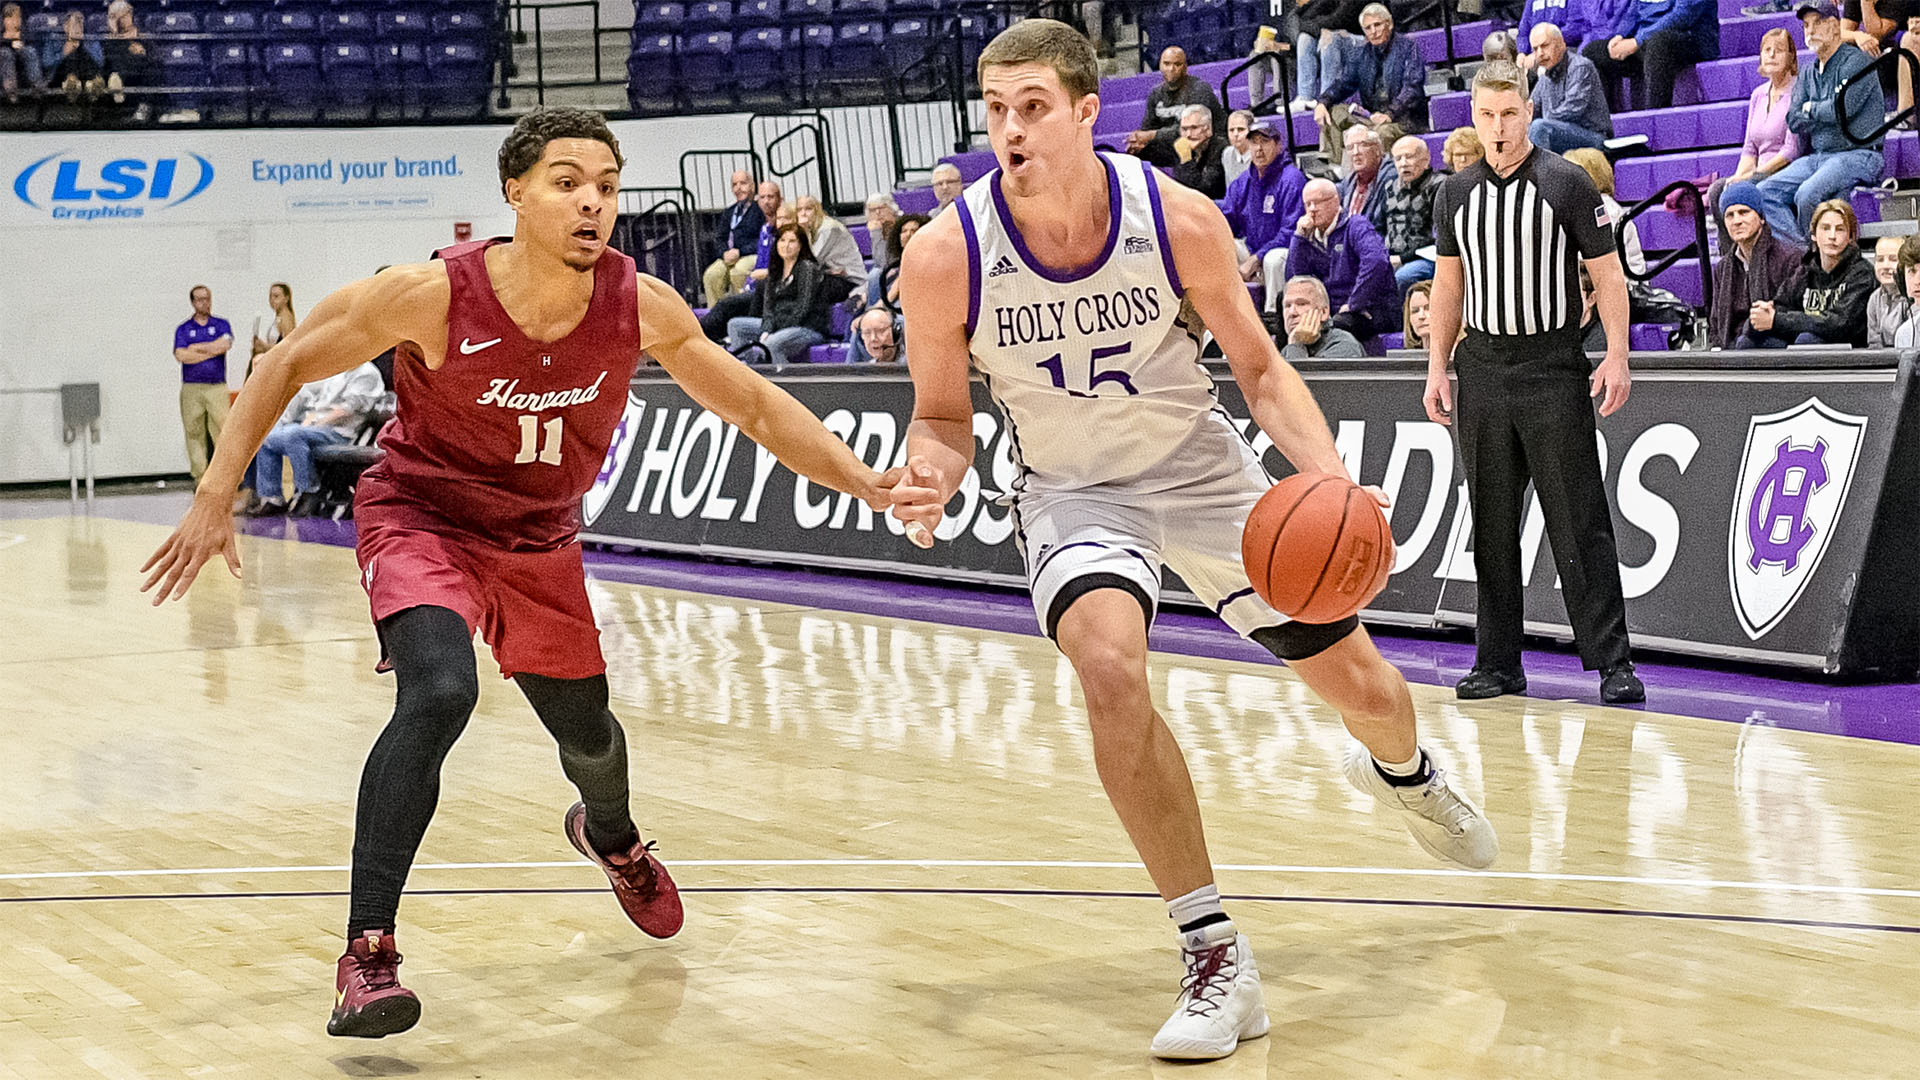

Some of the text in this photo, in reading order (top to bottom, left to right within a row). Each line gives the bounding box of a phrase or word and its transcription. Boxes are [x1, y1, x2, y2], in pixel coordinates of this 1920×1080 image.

[52, 158, 177, 201] LSI
[252, 154, 463, 186] Expand your brand.
[52, 205, 145, 220] Graphics
[995, 287, 1161, 347] HOLY CROSS
[542, 355, 552, 367] H
[1035, 341, 1140, 399] 15
[476, 371, 608, 412] Harvard
[514, 415, 564, 466] 11
[625, 407, 779, 523] HOLY
